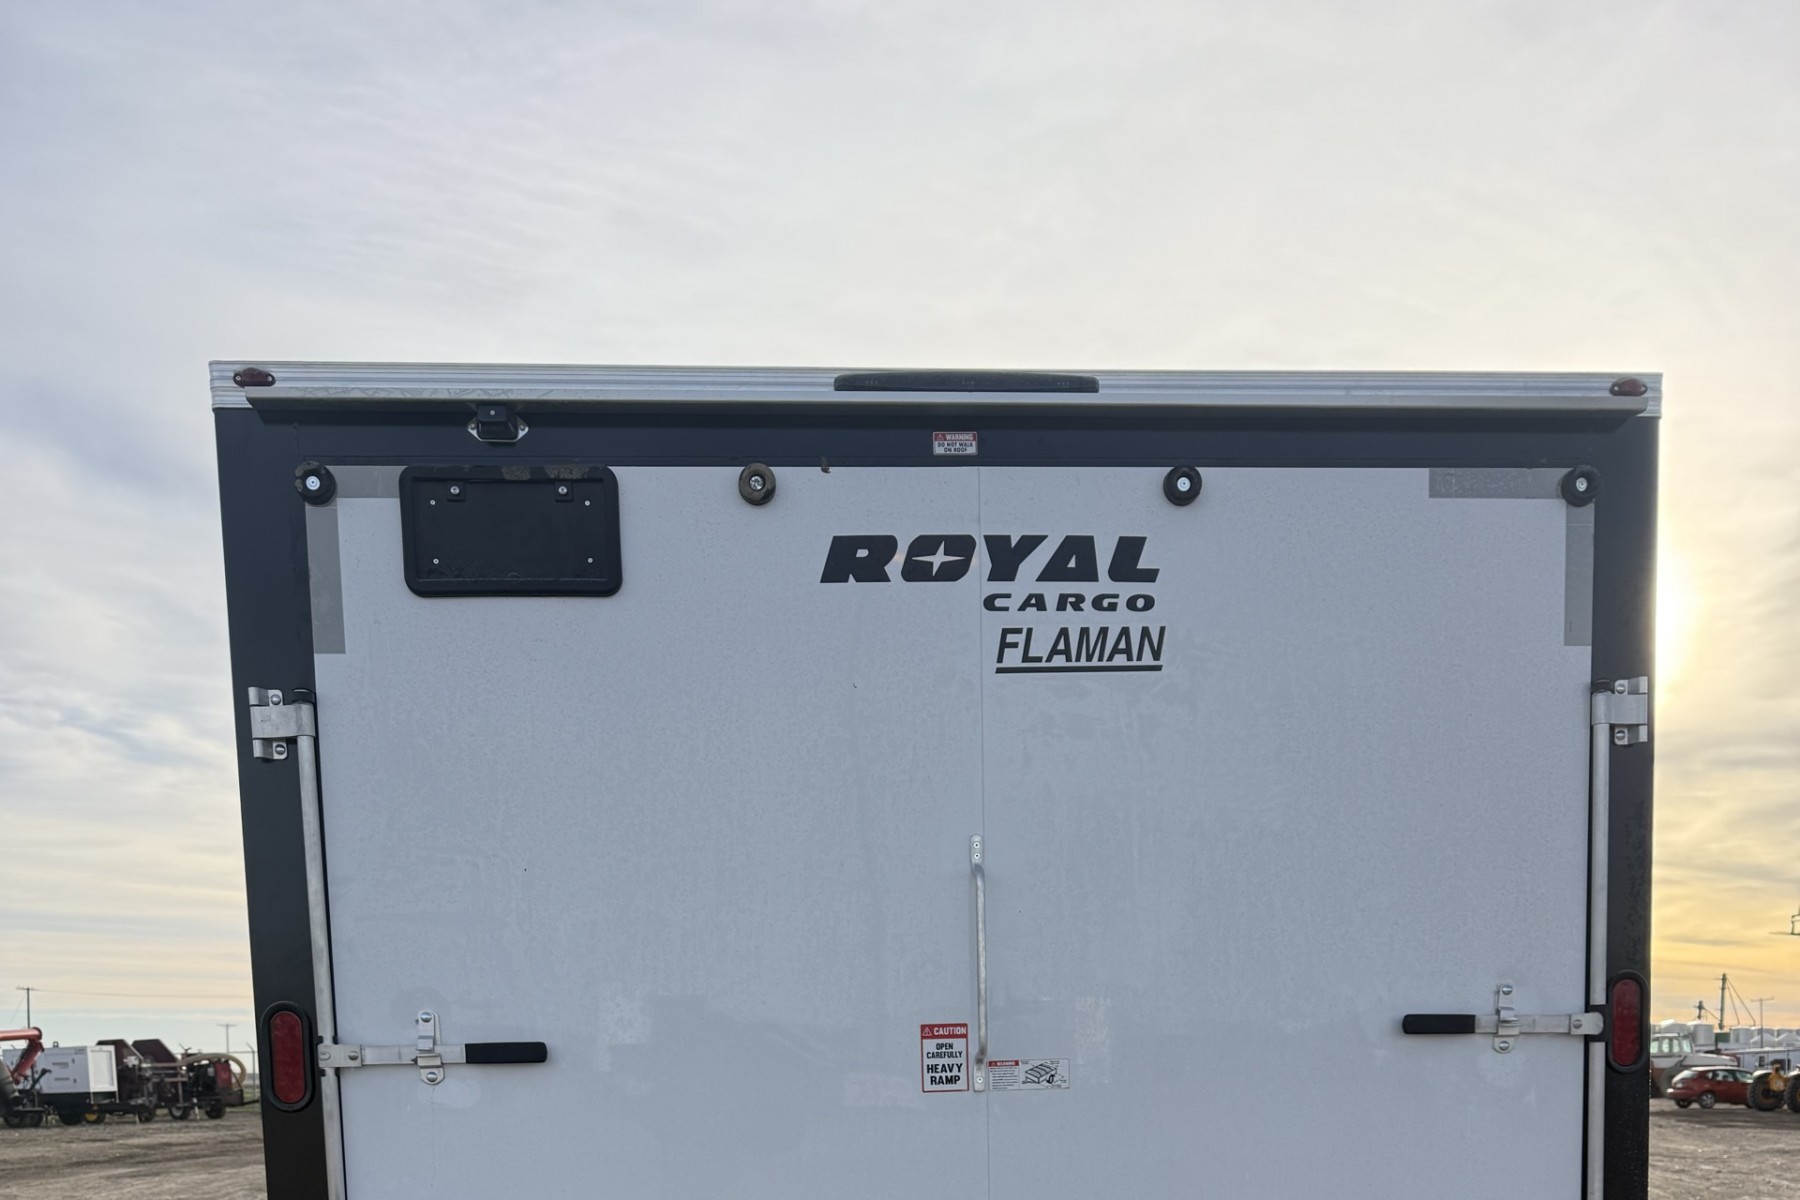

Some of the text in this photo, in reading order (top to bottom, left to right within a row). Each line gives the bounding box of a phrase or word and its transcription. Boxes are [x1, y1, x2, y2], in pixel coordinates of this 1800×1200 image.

[945, 433, 973, 441] WARNING
[820, 534, 1160, 583] ROYAL
[983, 593, 1155, 612] CARGO
[996, 626, 1166, 665] FLAMAN
[933, 1026, 967, 1036] CAUTION
[936, 1042, 954, 1050] OPEN
[926, 1051, 963, 1059] CAREFULLY
[926, 1063, 963, 1074] HEAVY
[930, 1075, 961, 1086] RAMP
